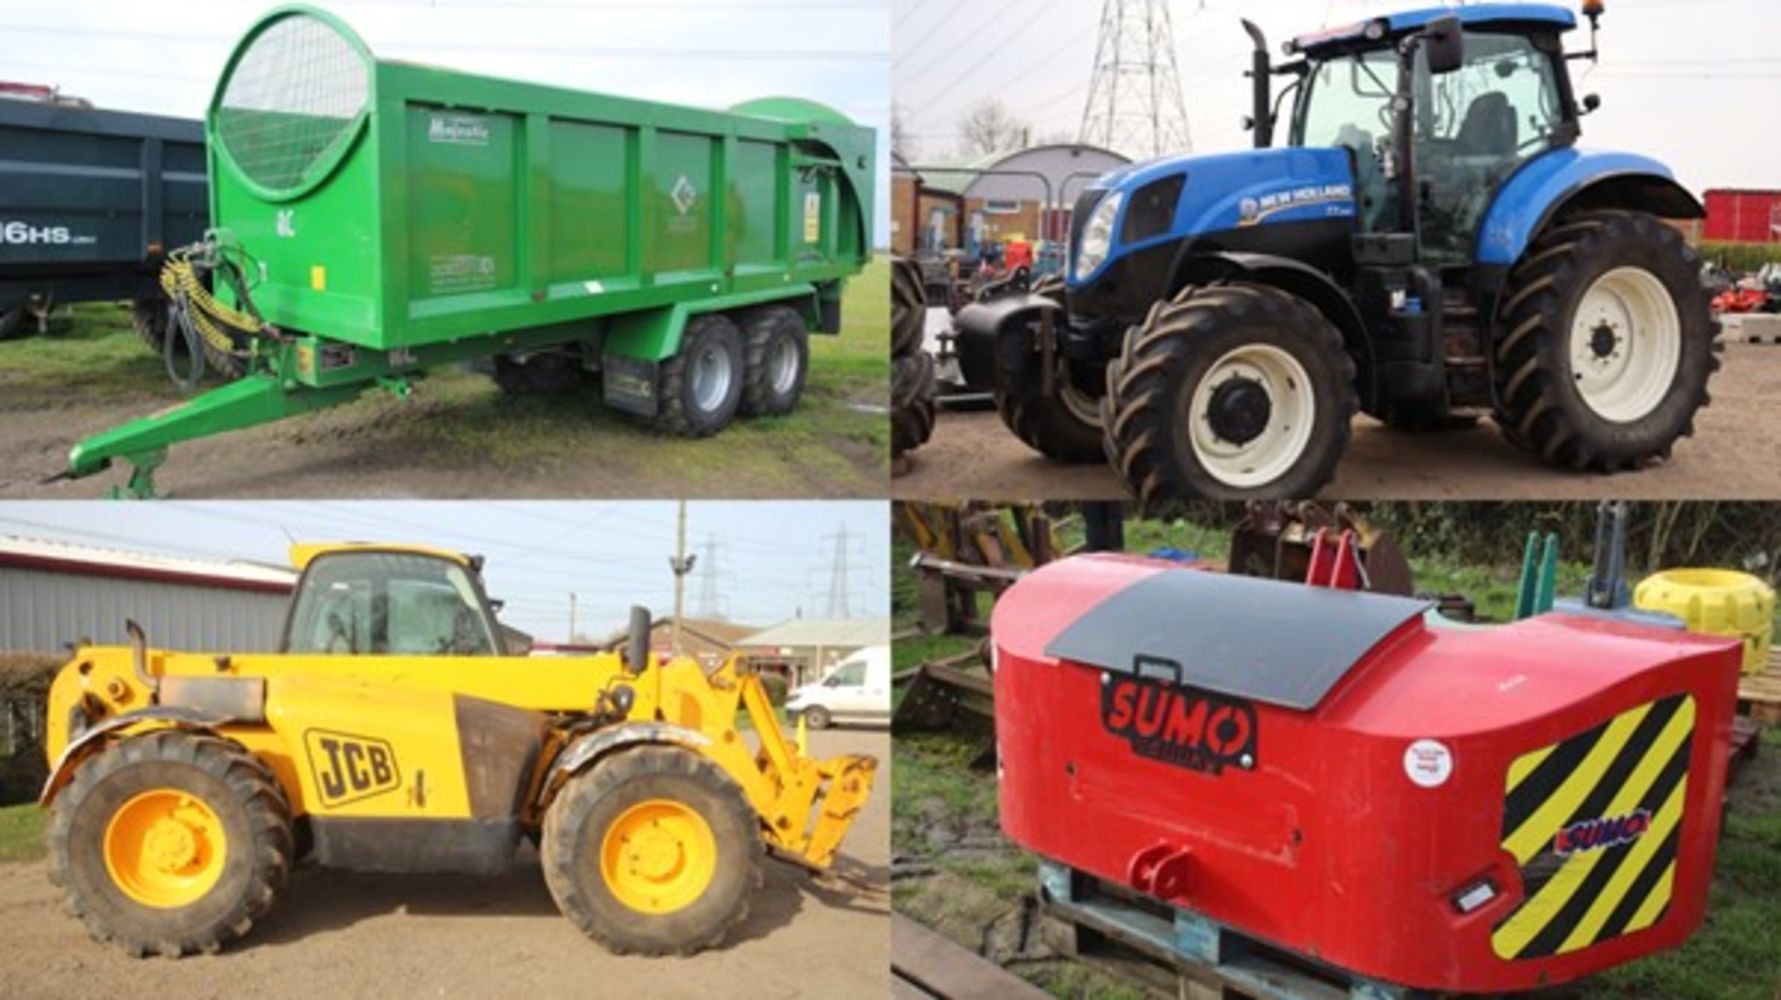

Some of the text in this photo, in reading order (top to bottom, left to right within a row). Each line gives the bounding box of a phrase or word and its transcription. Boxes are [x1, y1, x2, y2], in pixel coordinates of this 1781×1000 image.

[1260, 184, 1351, 207] NEW HOLLAND
[1108, 681, 1249, 756] SUMO
[320, 738, 392, 800] JCB
[1559, 810, 1648, 854] SUMO
